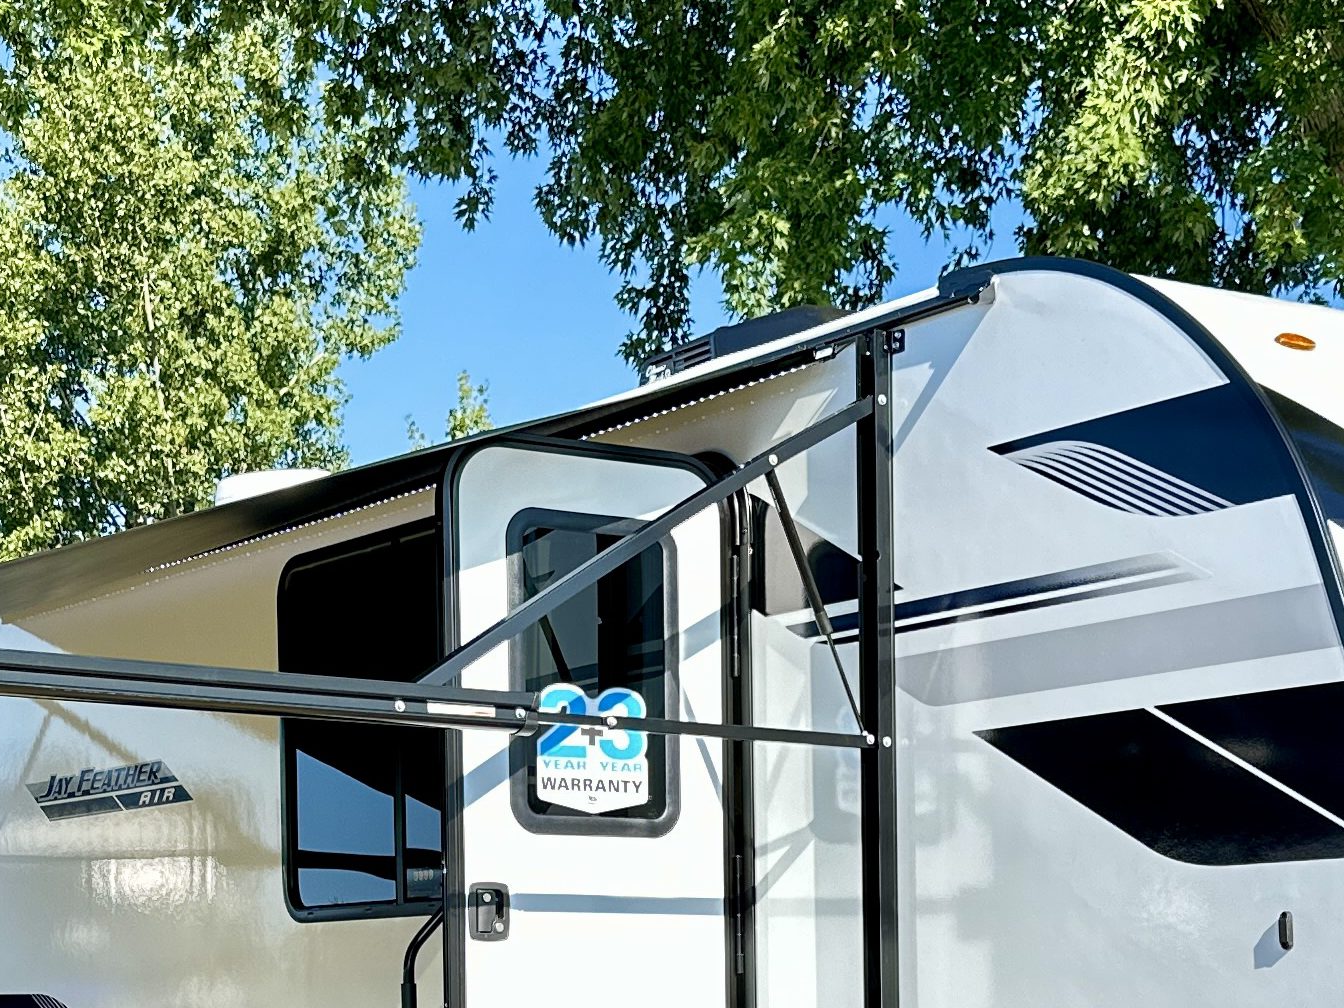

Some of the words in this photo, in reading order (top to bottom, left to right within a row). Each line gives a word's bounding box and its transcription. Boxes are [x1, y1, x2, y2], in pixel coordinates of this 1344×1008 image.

[543, 760, 586, 770] YEAR
[600, 762, 642, 772] YEAR
[39, 774, 74, 800] JAY
[75, 760, 162, 796] FEATHER
[542, 777, 643, 794] WARRANTY
[139, 787, 176, 806] AIR
